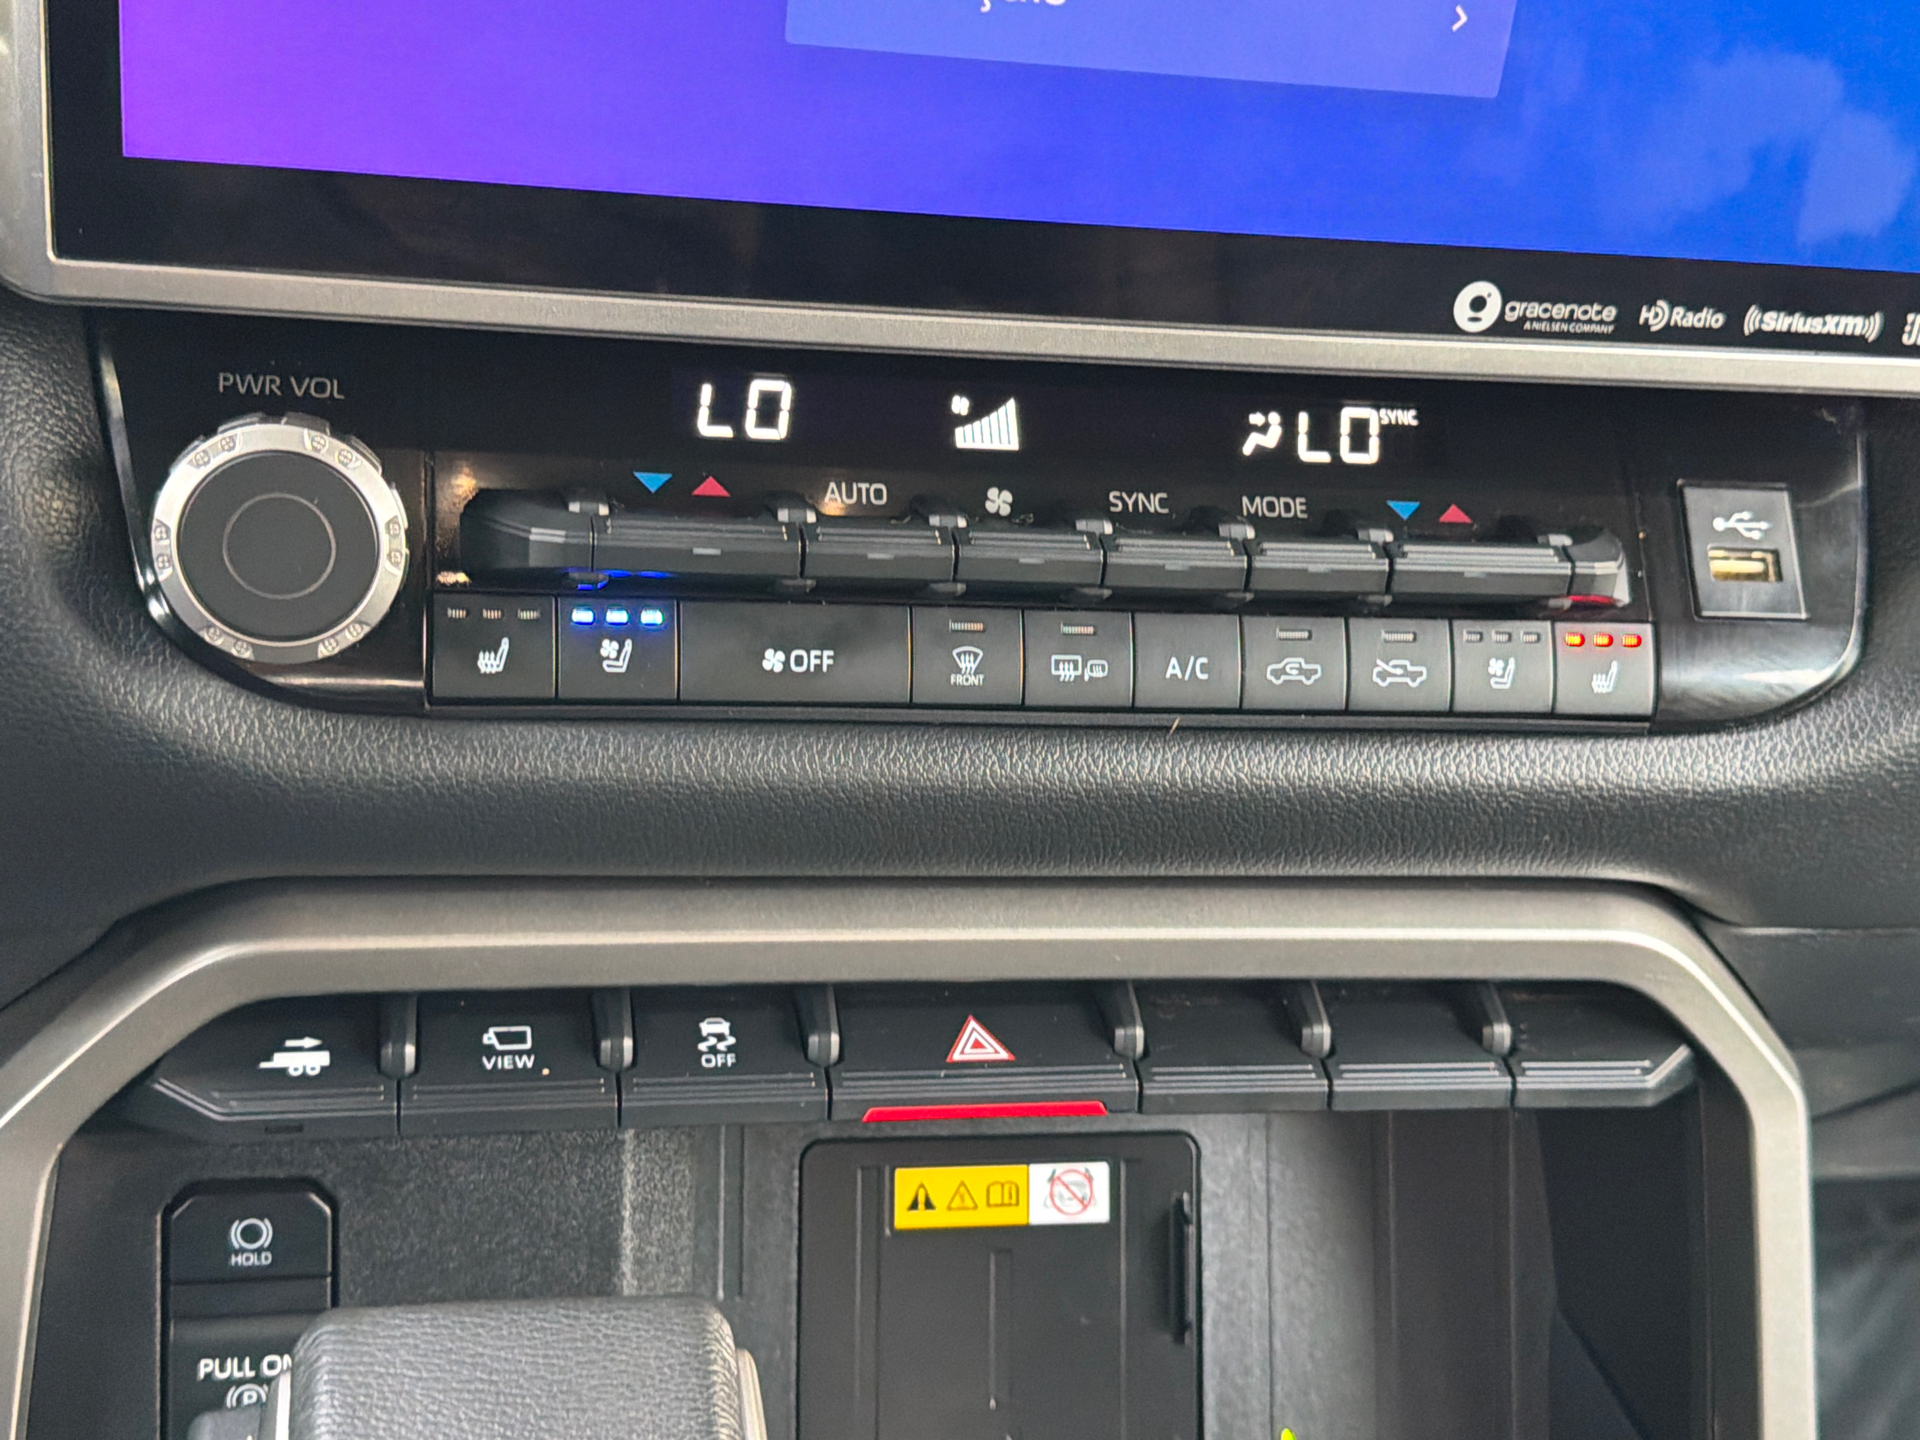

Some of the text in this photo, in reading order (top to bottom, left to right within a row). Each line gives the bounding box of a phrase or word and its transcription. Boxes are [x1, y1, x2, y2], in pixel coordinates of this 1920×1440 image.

[1504, 300, 1617, 322] gracenote
[1670, 307, 1726, 328] Radio
[1532, 321, 1568, 333] NIELSEN
[1569, 322, 1615, 335] COMPANY
[218, 373, 345, 400] PWR VOL
[697, 379, 794, 440] LO
[1380, 409, 1419, 427] SYNC
[1297, 407, 1380, 465] LO
[824, 482, 887, 506] AUTO
[1109, 491, 1170, 515] SYNC
[1242, 495, 1308, 519] MODE
[789, 649, 834, 673] OFF
[1165, 656, 1209, 681] A/C
[950, 674, 985, 686] FRONT
[482, 1055, 535, 1071] VIEW
[700, 1053, 737, 1069] OFF
[230, 1253, 273, 1268] HOLD
[198, 1356, 256, 1380] PULL
